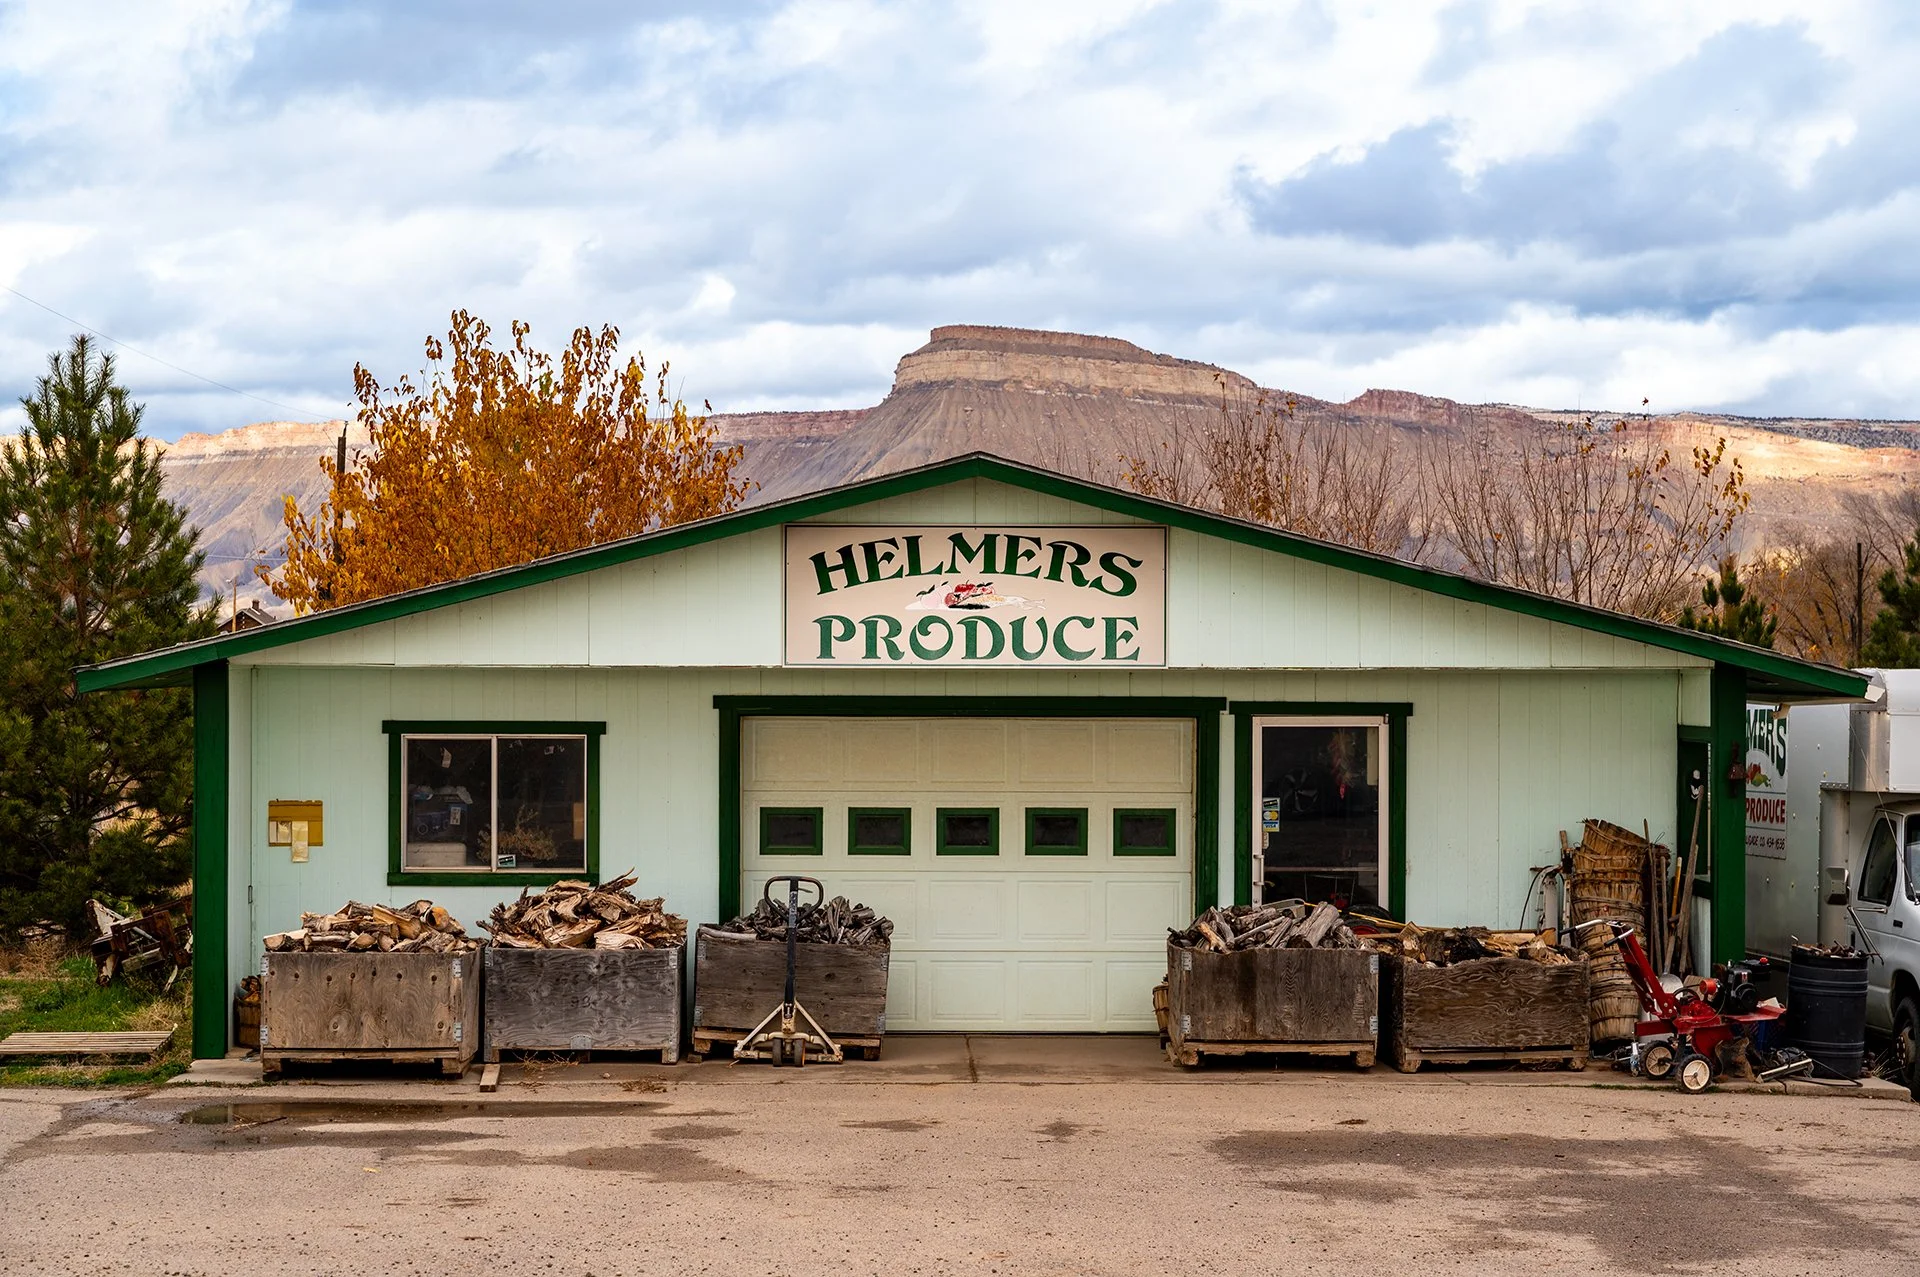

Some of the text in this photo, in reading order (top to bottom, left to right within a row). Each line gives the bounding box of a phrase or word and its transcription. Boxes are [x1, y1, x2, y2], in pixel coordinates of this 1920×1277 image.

[808, 531, 1144, 597] HELMERS
[812, 615, 1141, 661] PRODUCE
[1746, 797, 1786, 824] PRODUCE
